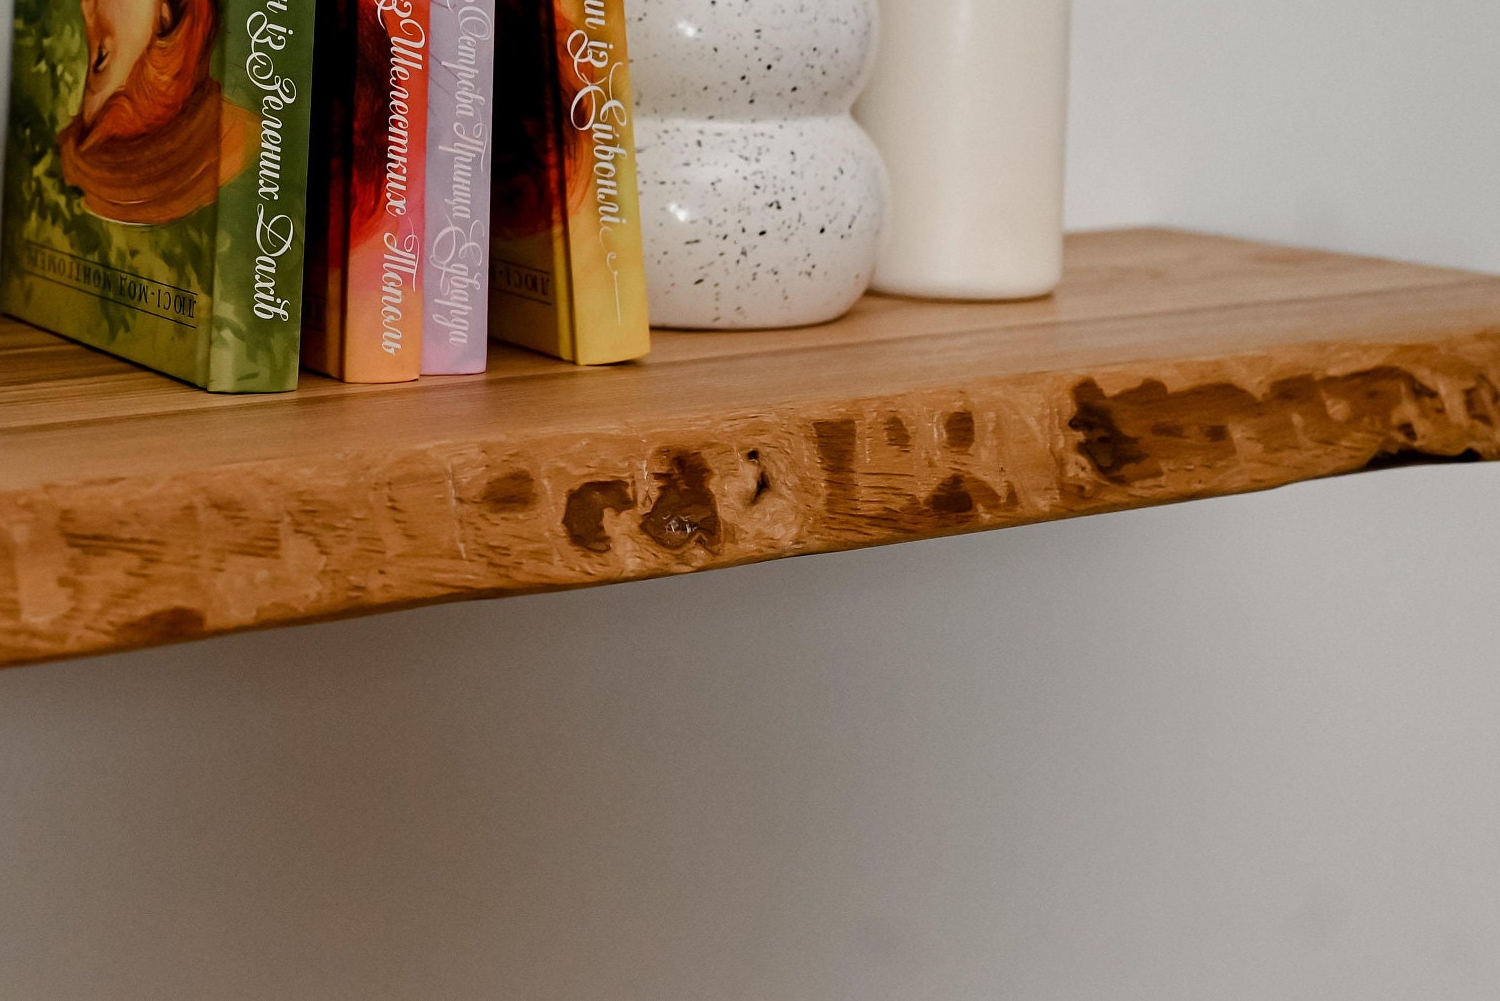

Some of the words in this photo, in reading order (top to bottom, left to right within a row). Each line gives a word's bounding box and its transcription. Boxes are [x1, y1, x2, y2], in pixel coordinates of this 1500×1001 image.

[247, 9, 293, 53] із
[441, 5, 491, 116] Острова
[566, 29, 608, 78] із
[246, 51, 297, 201] Зелених
[383, 17, 426, 216] Шелестких
[438, 121, 489, 220] Принца
[571, 61, 628, 230] Ейвонлі
[118, 274, 197, 319] ЛЮСІ-МОД
[252, 203, 294, 322] Дахів
[381, 220, 418, 355] Тополь
[433, 213, 485, 345] Едварда
